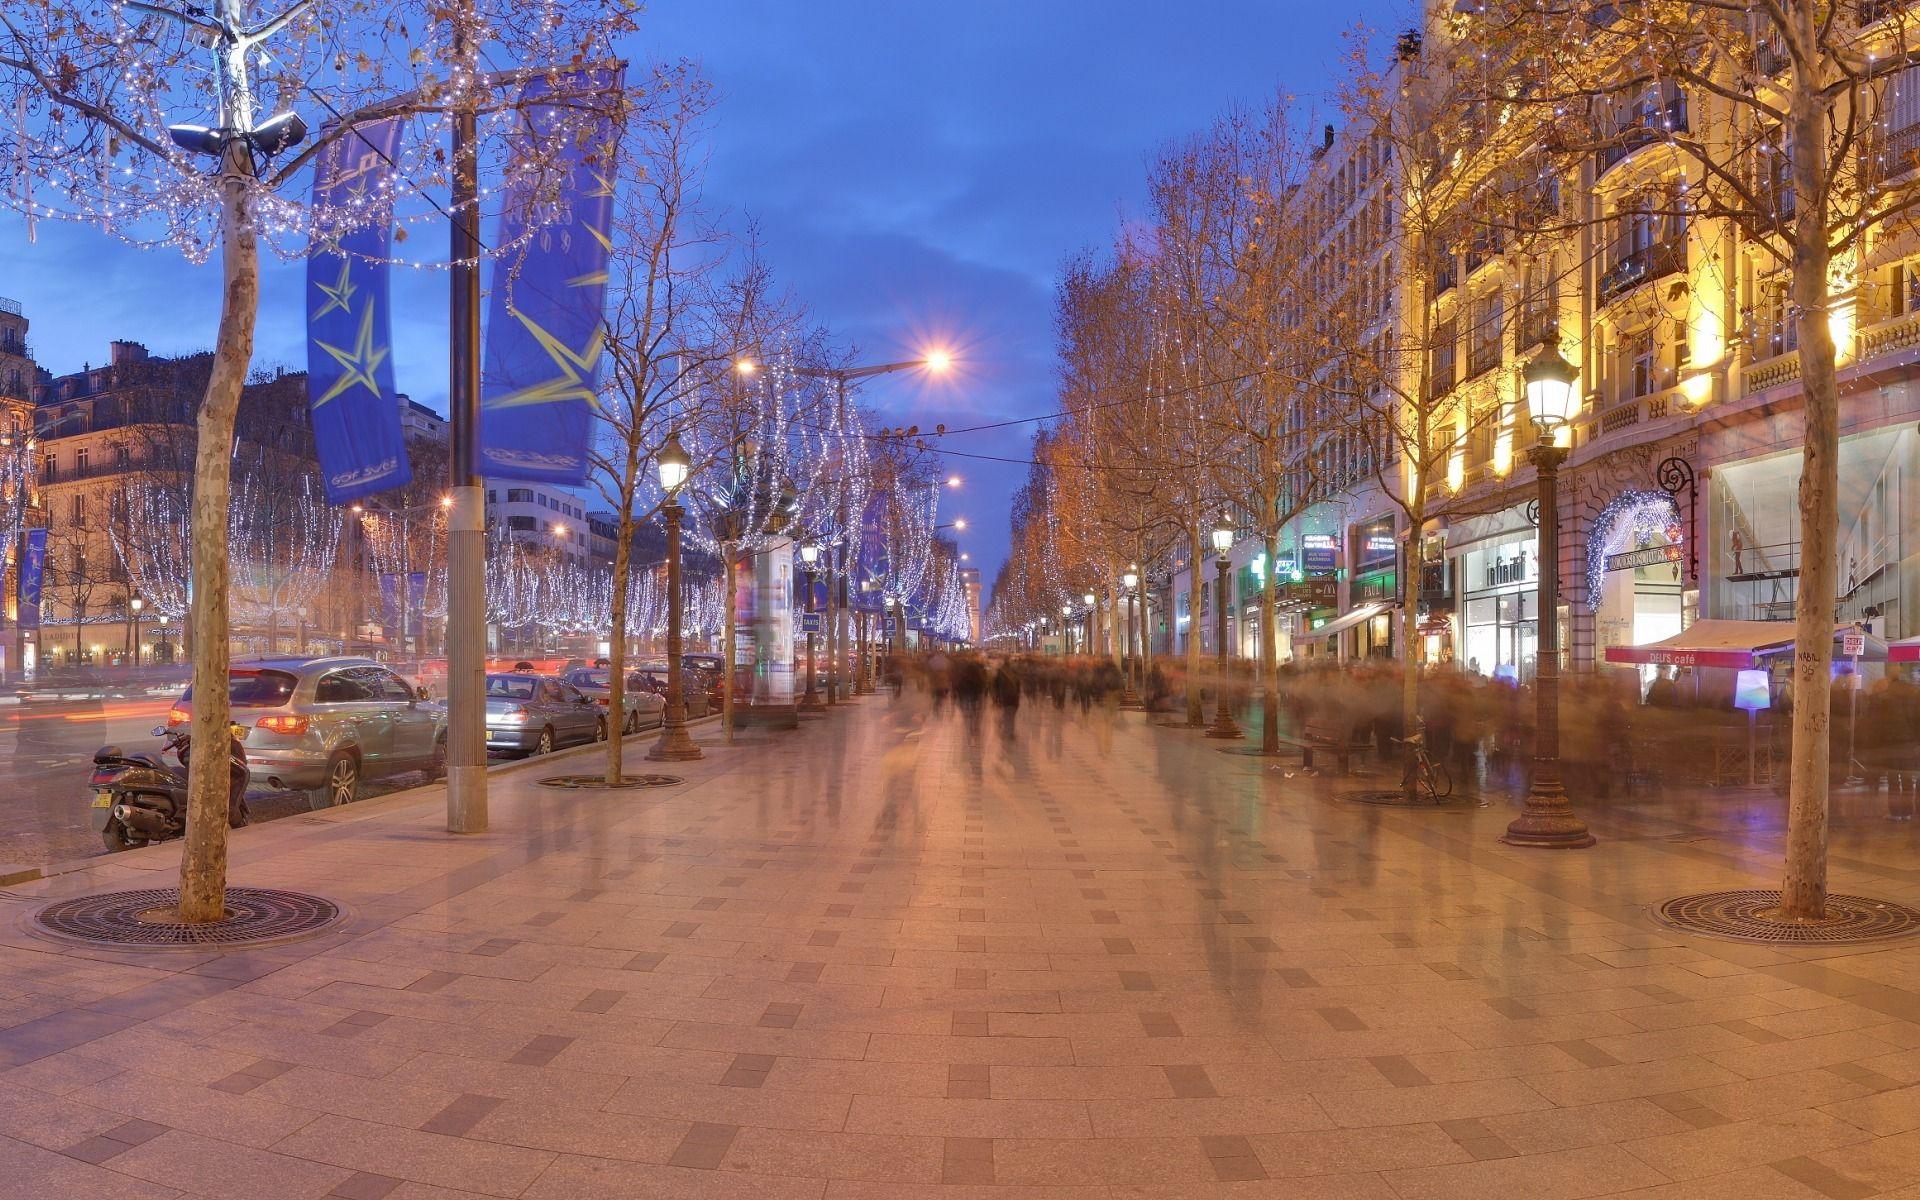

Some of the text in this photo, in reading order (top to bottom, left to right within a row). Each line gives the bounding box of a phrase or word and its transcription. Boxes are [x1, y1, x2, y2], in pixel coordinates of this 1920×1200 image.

[1364, 584, 1380, 597] PAUL
[803, 618, 819, 626] TAXIS
[886, 620, 893, 629] P
[1674, 654, 1695, 665] café
